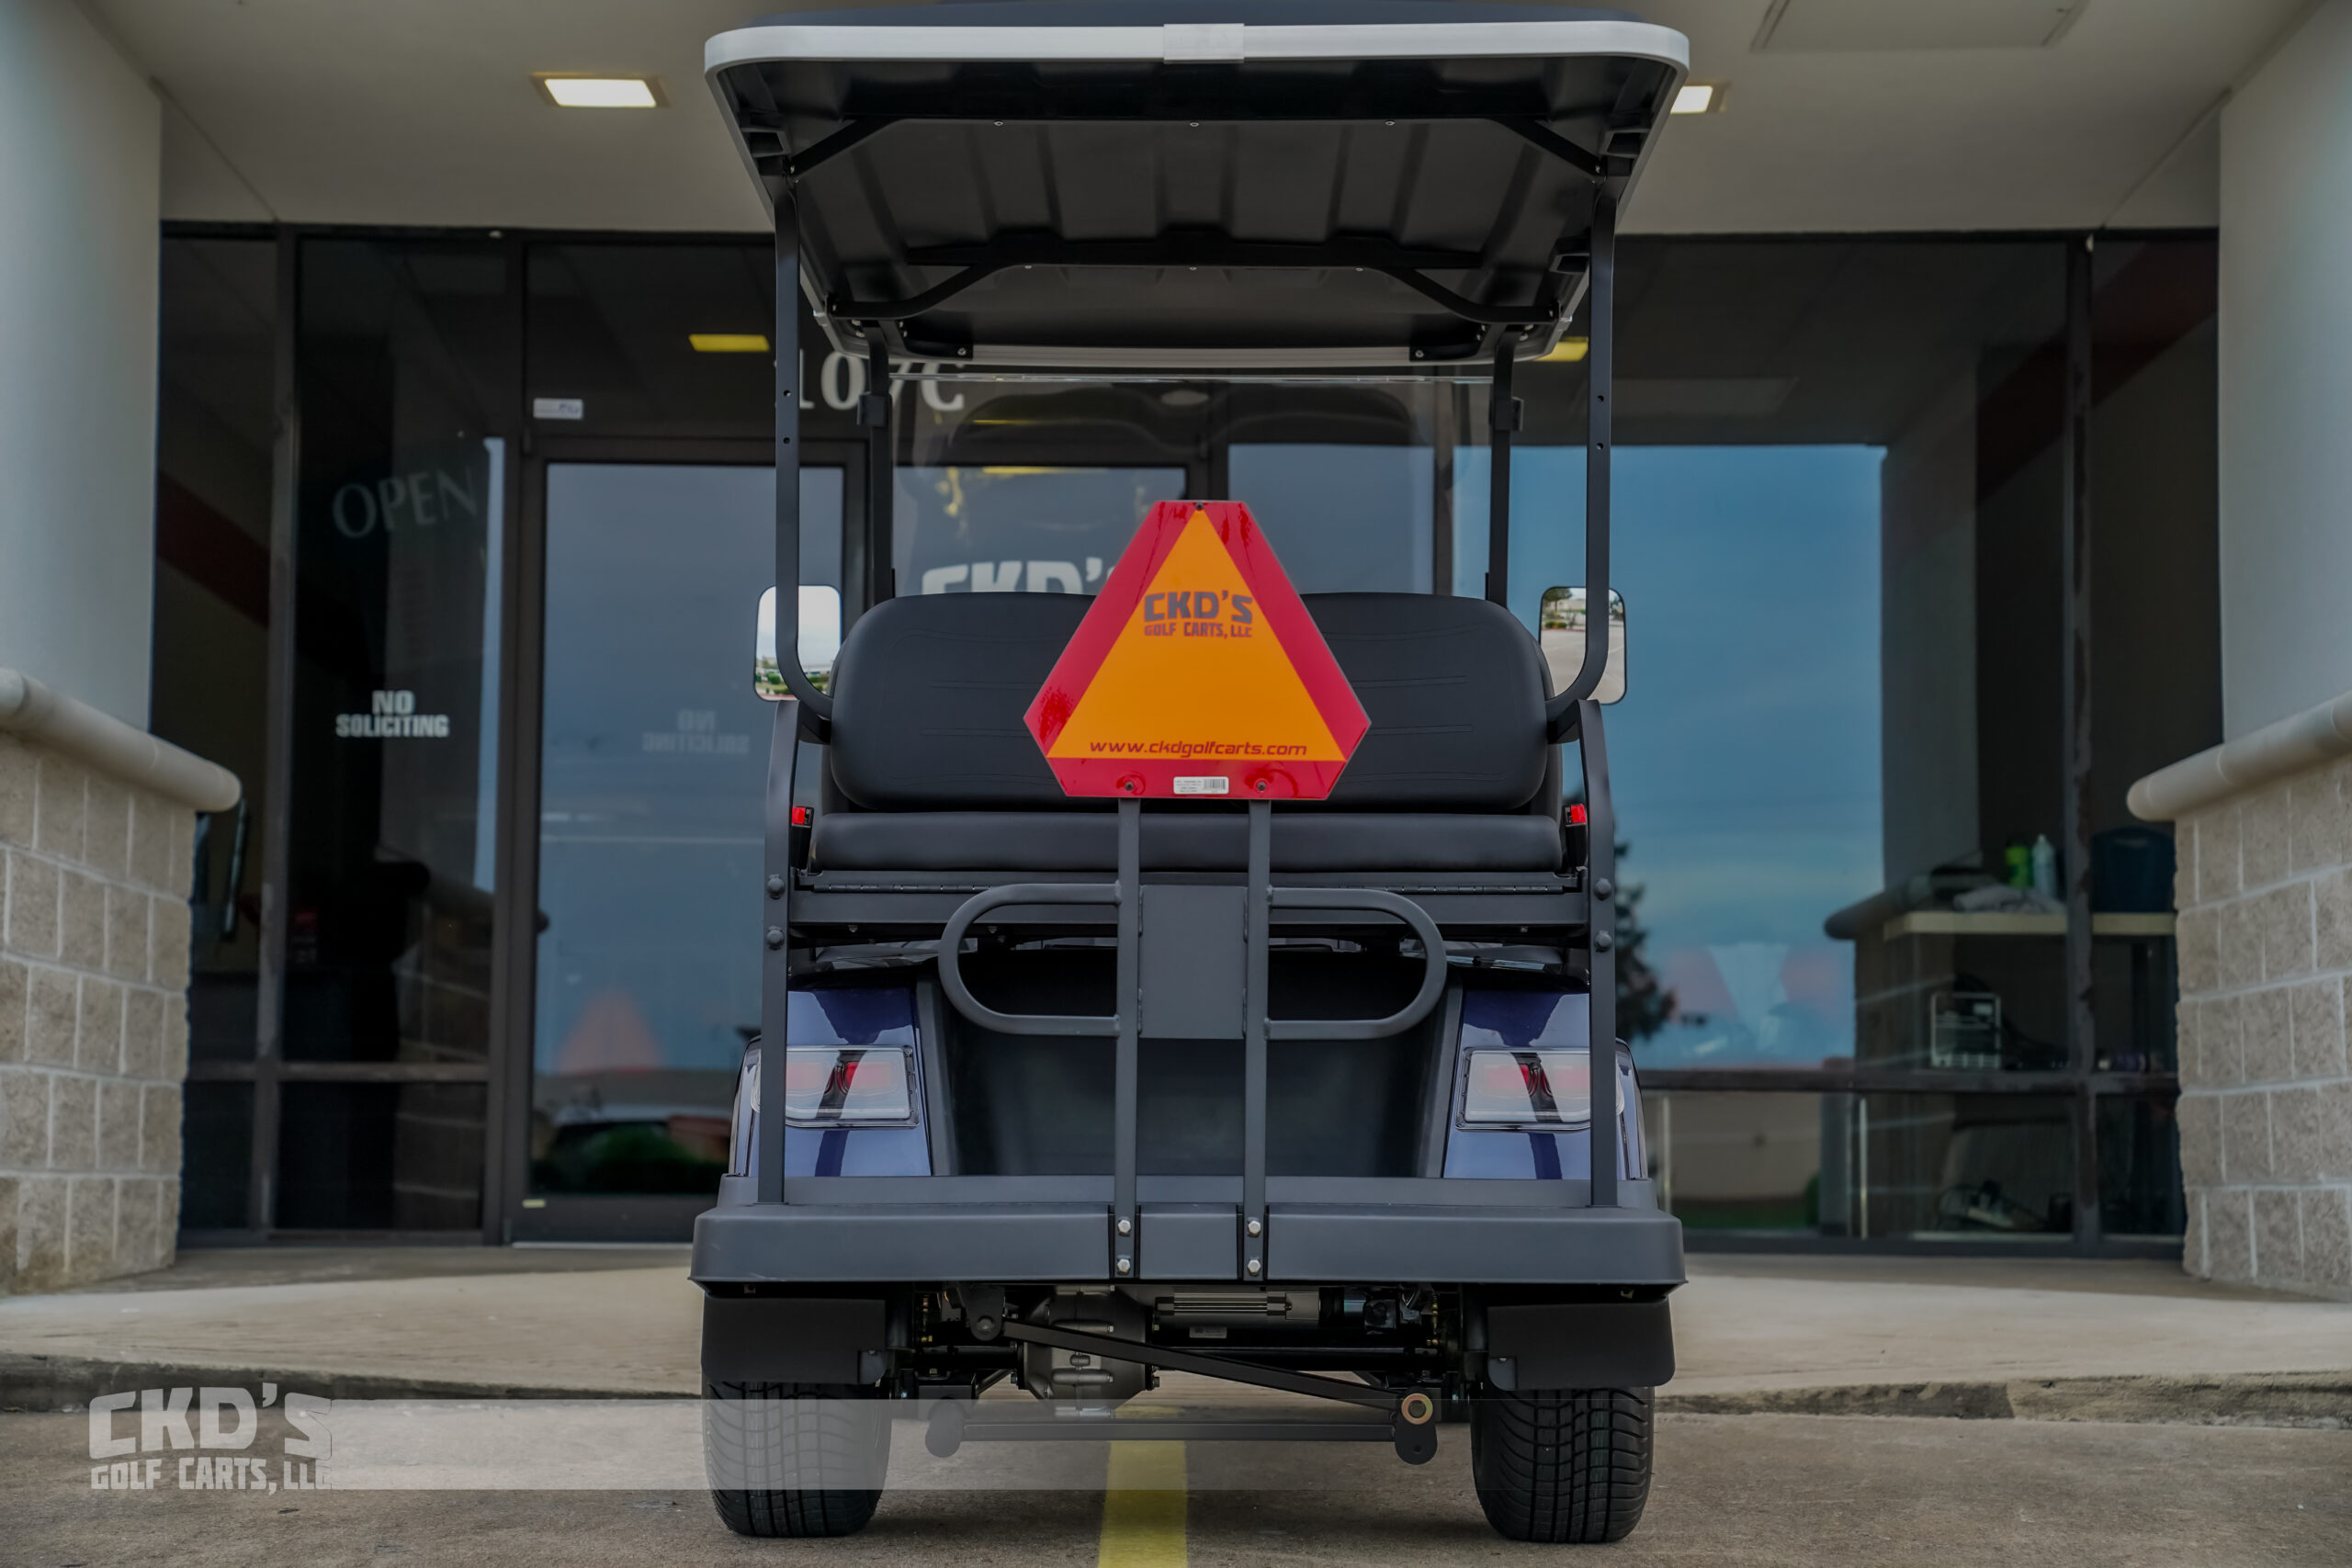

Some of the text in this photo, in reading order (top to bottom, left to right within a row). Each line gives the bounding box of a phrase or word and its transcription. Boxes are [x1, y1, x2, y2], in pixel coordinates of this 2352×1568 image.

[775, 349, 965, 411] 0C
[333, 465, 479, 538] OPEN
[1145, 590, 1252, 624] CKD'S
[1145, 622, 1252, 639] GOLF CARTS, LLC
[372, 690, 415, 715] NO
[336, 714, 449, 738] SOLICITING
[1091, 740, 1307, 758] www.ckdgolfcarts.com
